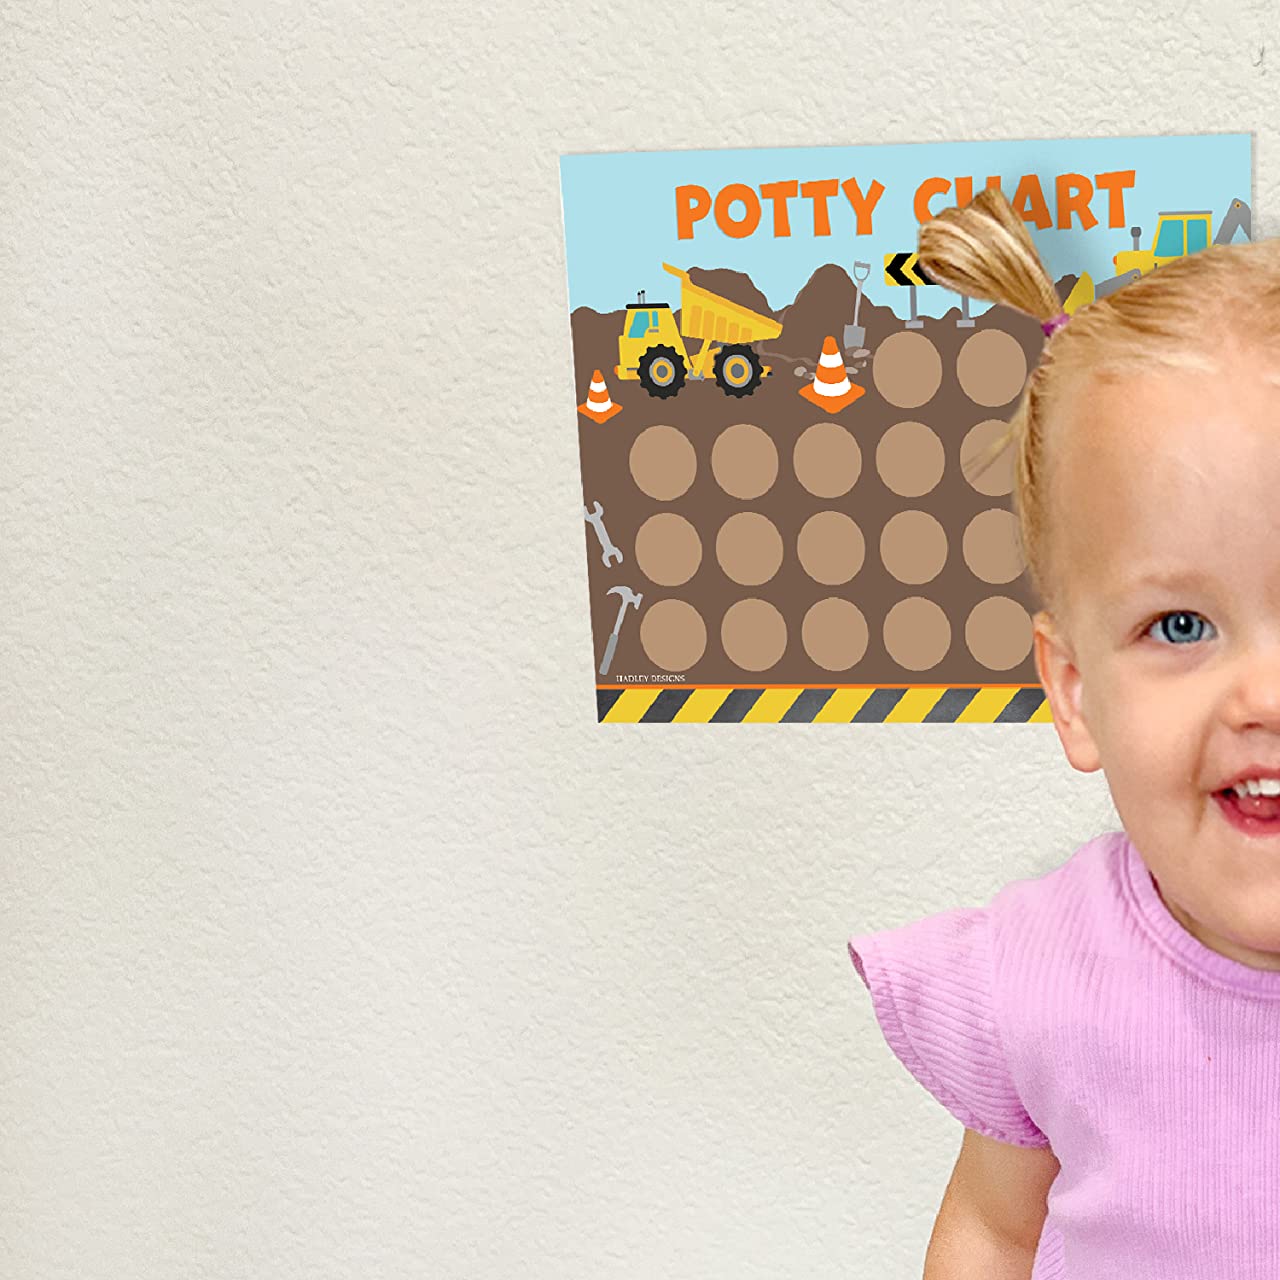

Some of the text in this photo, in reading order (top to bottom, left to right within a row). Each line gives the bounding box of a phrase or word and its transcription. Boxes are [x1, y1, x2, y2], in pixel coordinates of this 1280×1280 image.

[676, 178, 884, 239] POTTY
[616, 674, 686, 682] HADLEY DESIGNS
